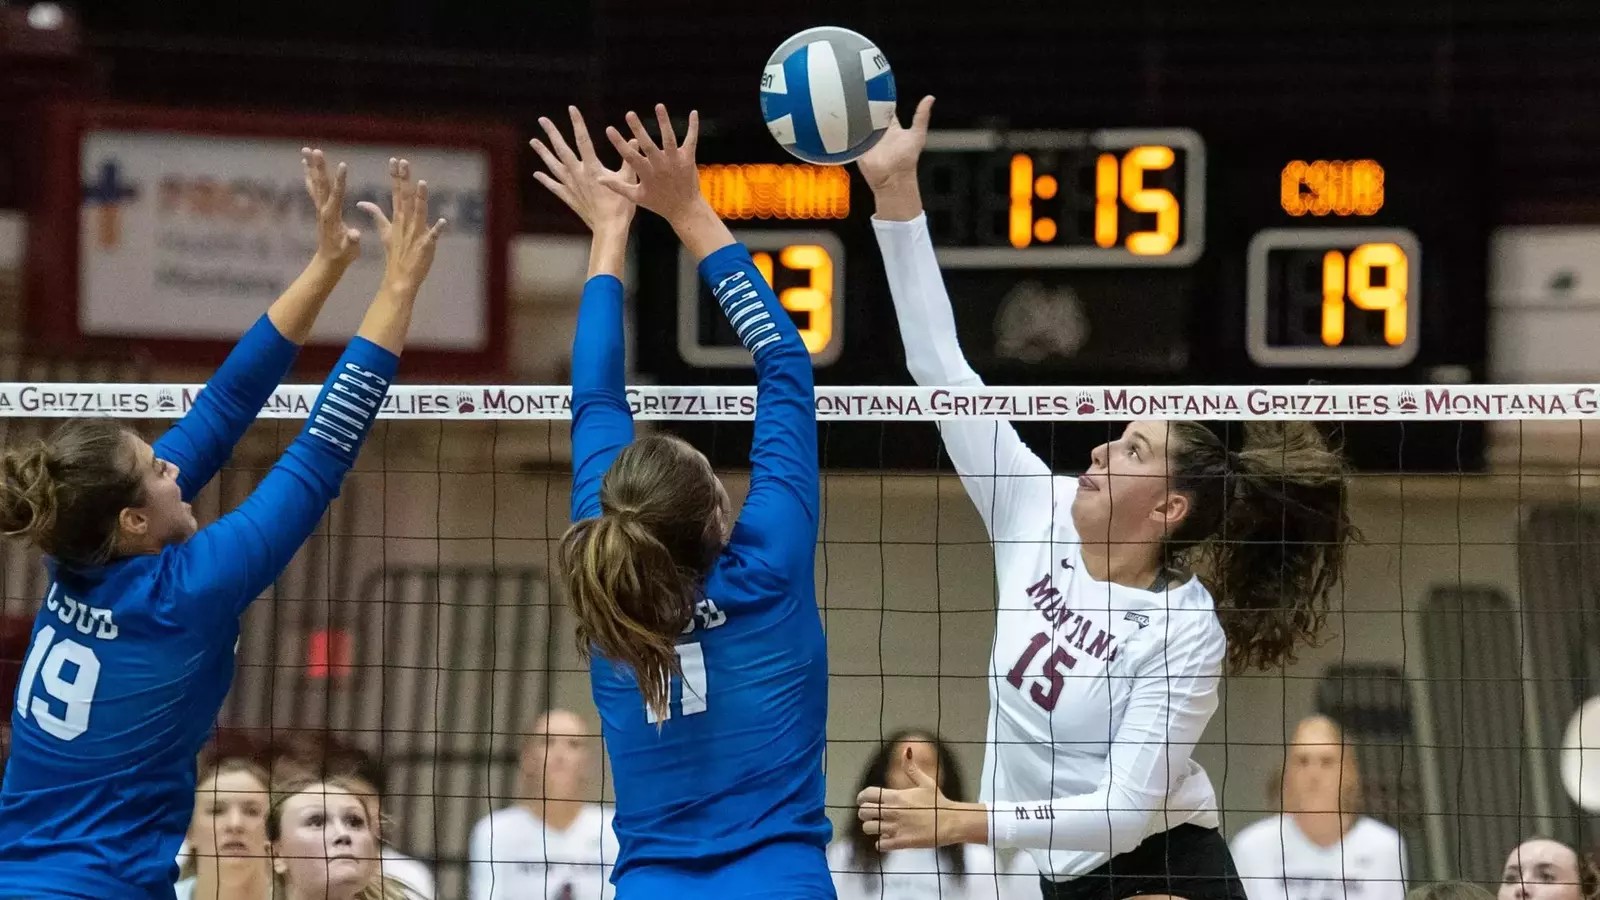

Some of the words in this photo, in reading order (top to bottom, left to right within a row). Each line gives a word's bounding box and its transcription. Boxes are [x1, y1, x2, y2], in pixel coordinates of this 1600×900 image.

[1009, 145, 1180, 256] 1:15
[713, 271, 782, 356] RUNNERS
[1322, 243, 1408, 347] 19
[19, 386, 149, 413] GRIZZLIES
[815, 394, 924, 415] ONTANA
[930, 389, 1069, 416] GRIZZLIES
[1103, 389, 1241, 415] MONTANA
[1247, 388, 1389, 416] GRIZZLIES
[1425, 388, 1566, 416] MONTANA
[308, 362, 388, 453] RUNNERS
[16, 624, 101, 741] 19
[1006, 631, 1077, 712] 15
